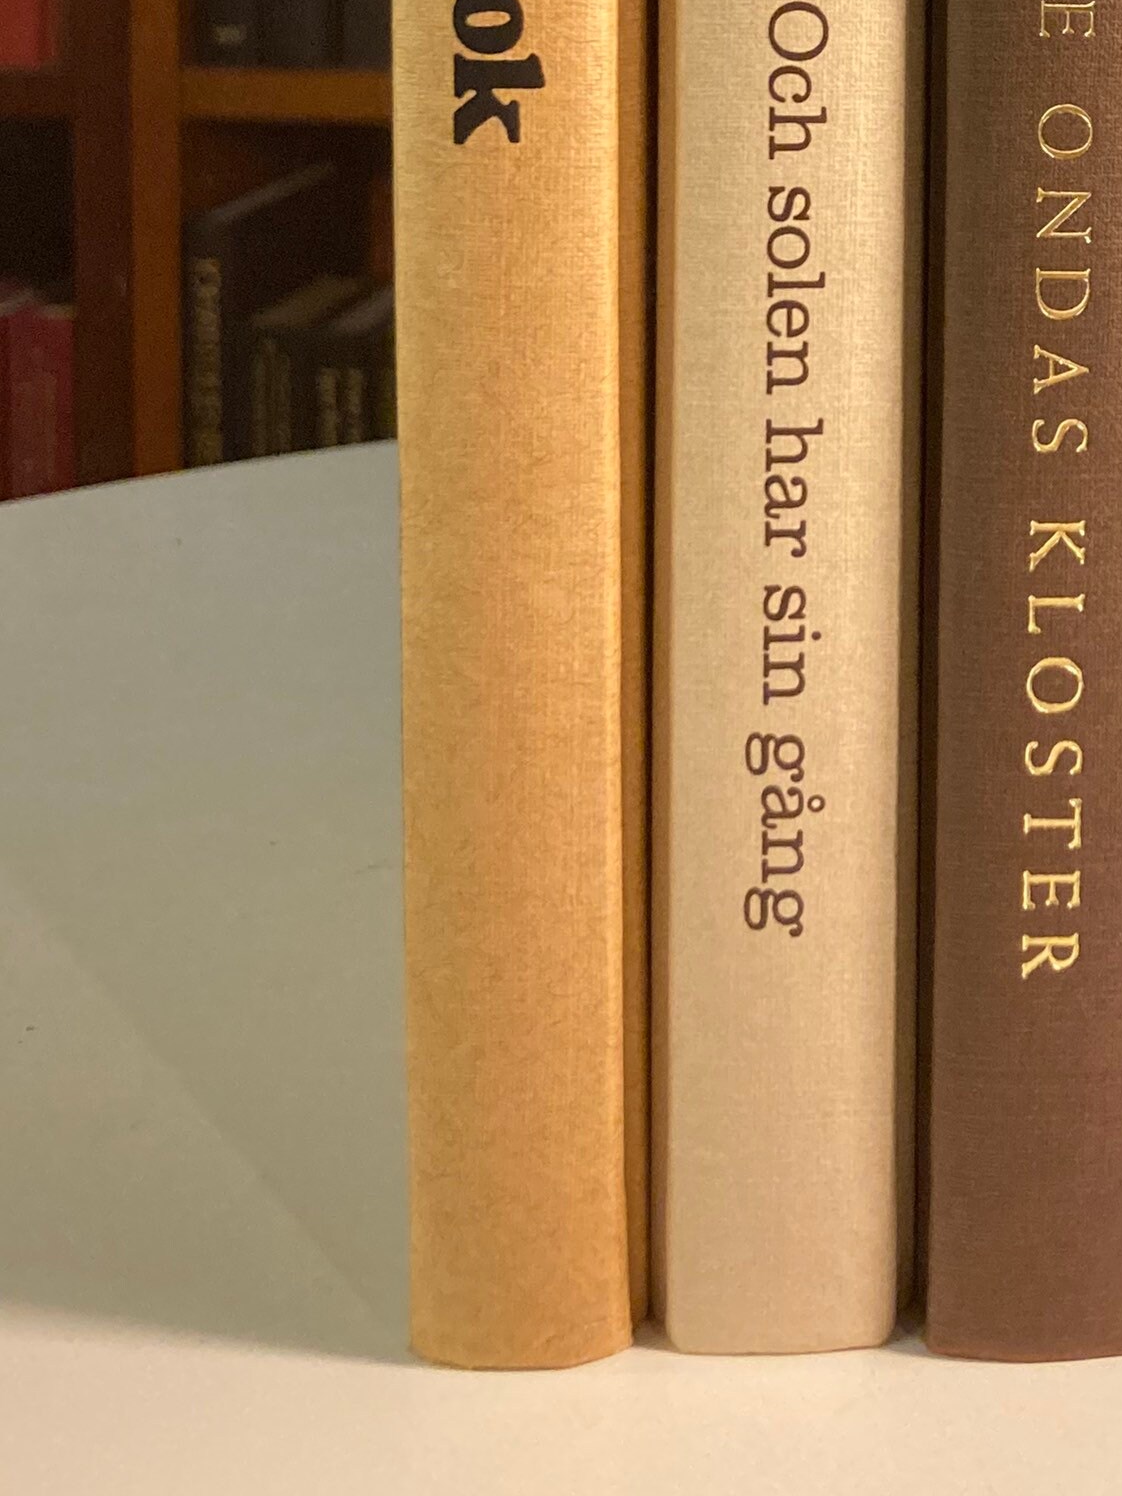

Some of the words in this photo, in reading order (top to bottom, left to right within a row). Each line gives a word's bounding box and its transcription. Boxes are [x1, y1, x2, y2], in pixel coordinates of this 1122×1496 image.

[766, 1, 829, 161] Och
[765, 184, 826, 396] solen
[1030, 103, 1094, 454] ONDAS
[763, 418, 823, 558] har
[761, 585, 822, 707] sin
[1020, 518, 1086, 979] KLOSTER
[744, 732, 825, 937] gång
